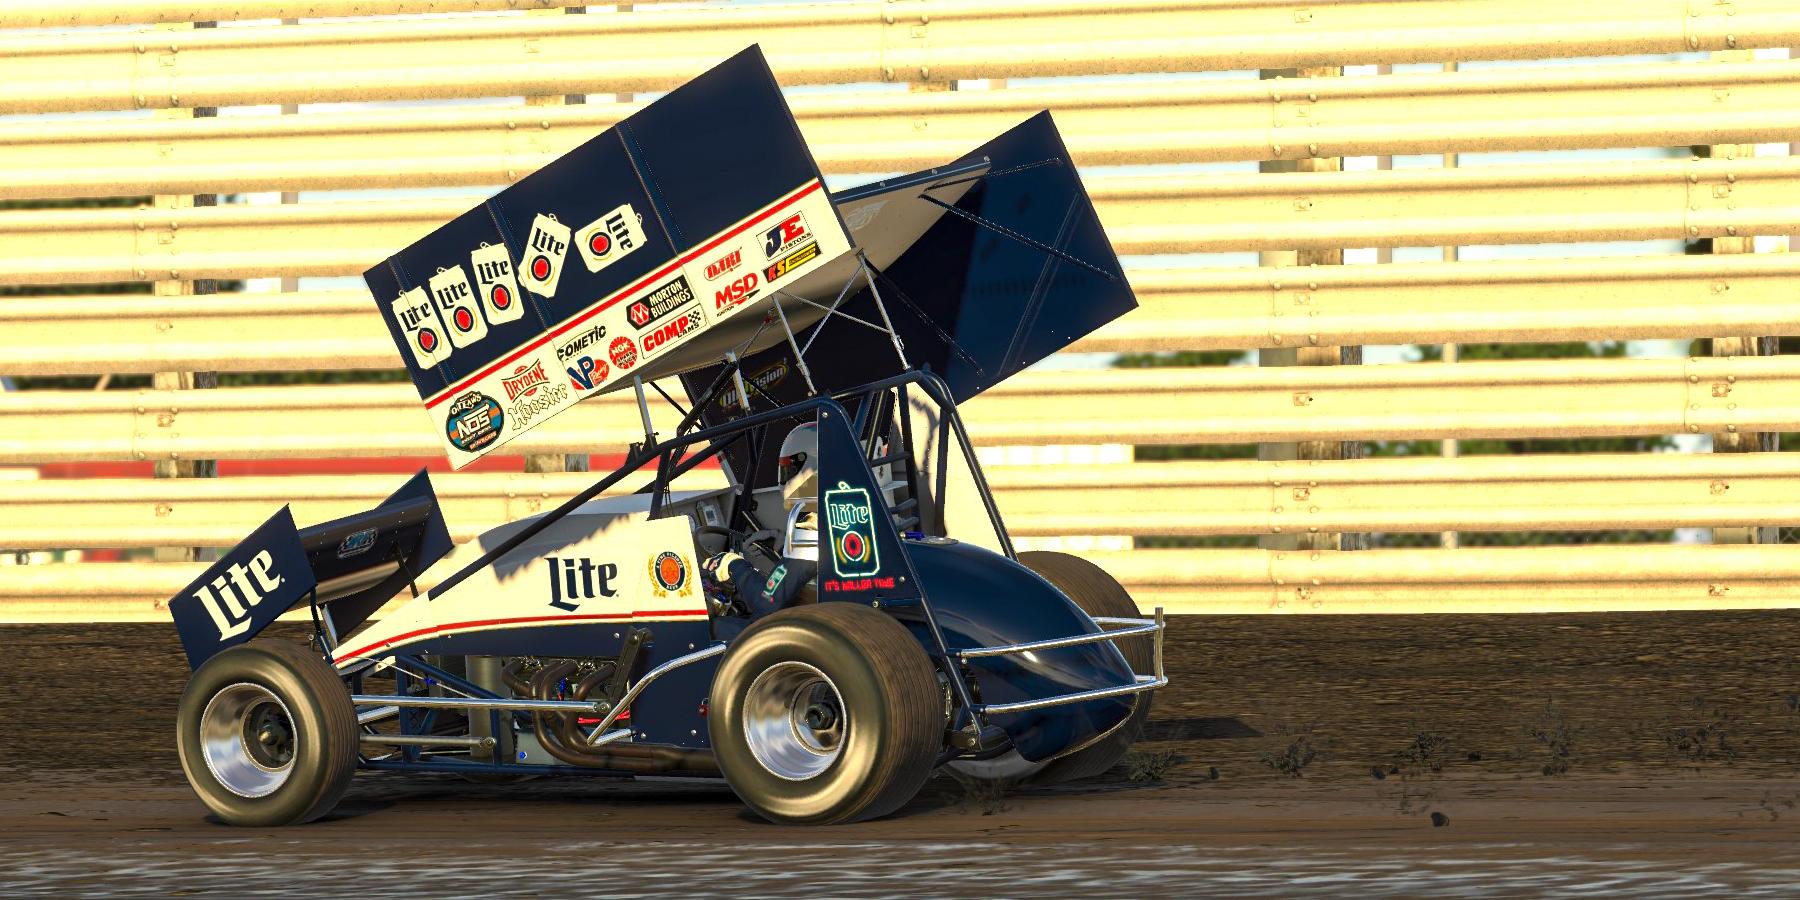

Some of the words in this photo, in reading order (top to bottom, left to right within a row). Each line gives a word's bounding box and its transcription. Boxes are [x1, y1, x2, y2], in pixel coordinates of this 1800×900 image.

[531, 227, 565, 256] Lite
[606, 211, 634, 250] Lite
[765, 214, 805, 258] JE
[780, 233, 812, 252] PISTONS
[477, 259, 510, 286] Lite
[437, 280, 469, 310] Lite
[649, 280, 683, 306] MORTON
[651, 288, 691, 318] BUILDINGS
[715, 272, 758, 310] MSD
[399, 301, 431, 332] Lite
[677, 323, 700, 338] CAMS
[557, 325, 606, 361] COMETIC
[644, 316, 689, 352] COMP
[502, 361, 548, 401] DRYDENE
[456, 404, 492, 439] NOS
[508, 384, 567, 431] Hoosier
[830, 503, 869, 530] Lite
[193, 549, 282, 642] Lite
[544, 557, 618, 612] Lite
[825, 581, 840, 592] IT'S
